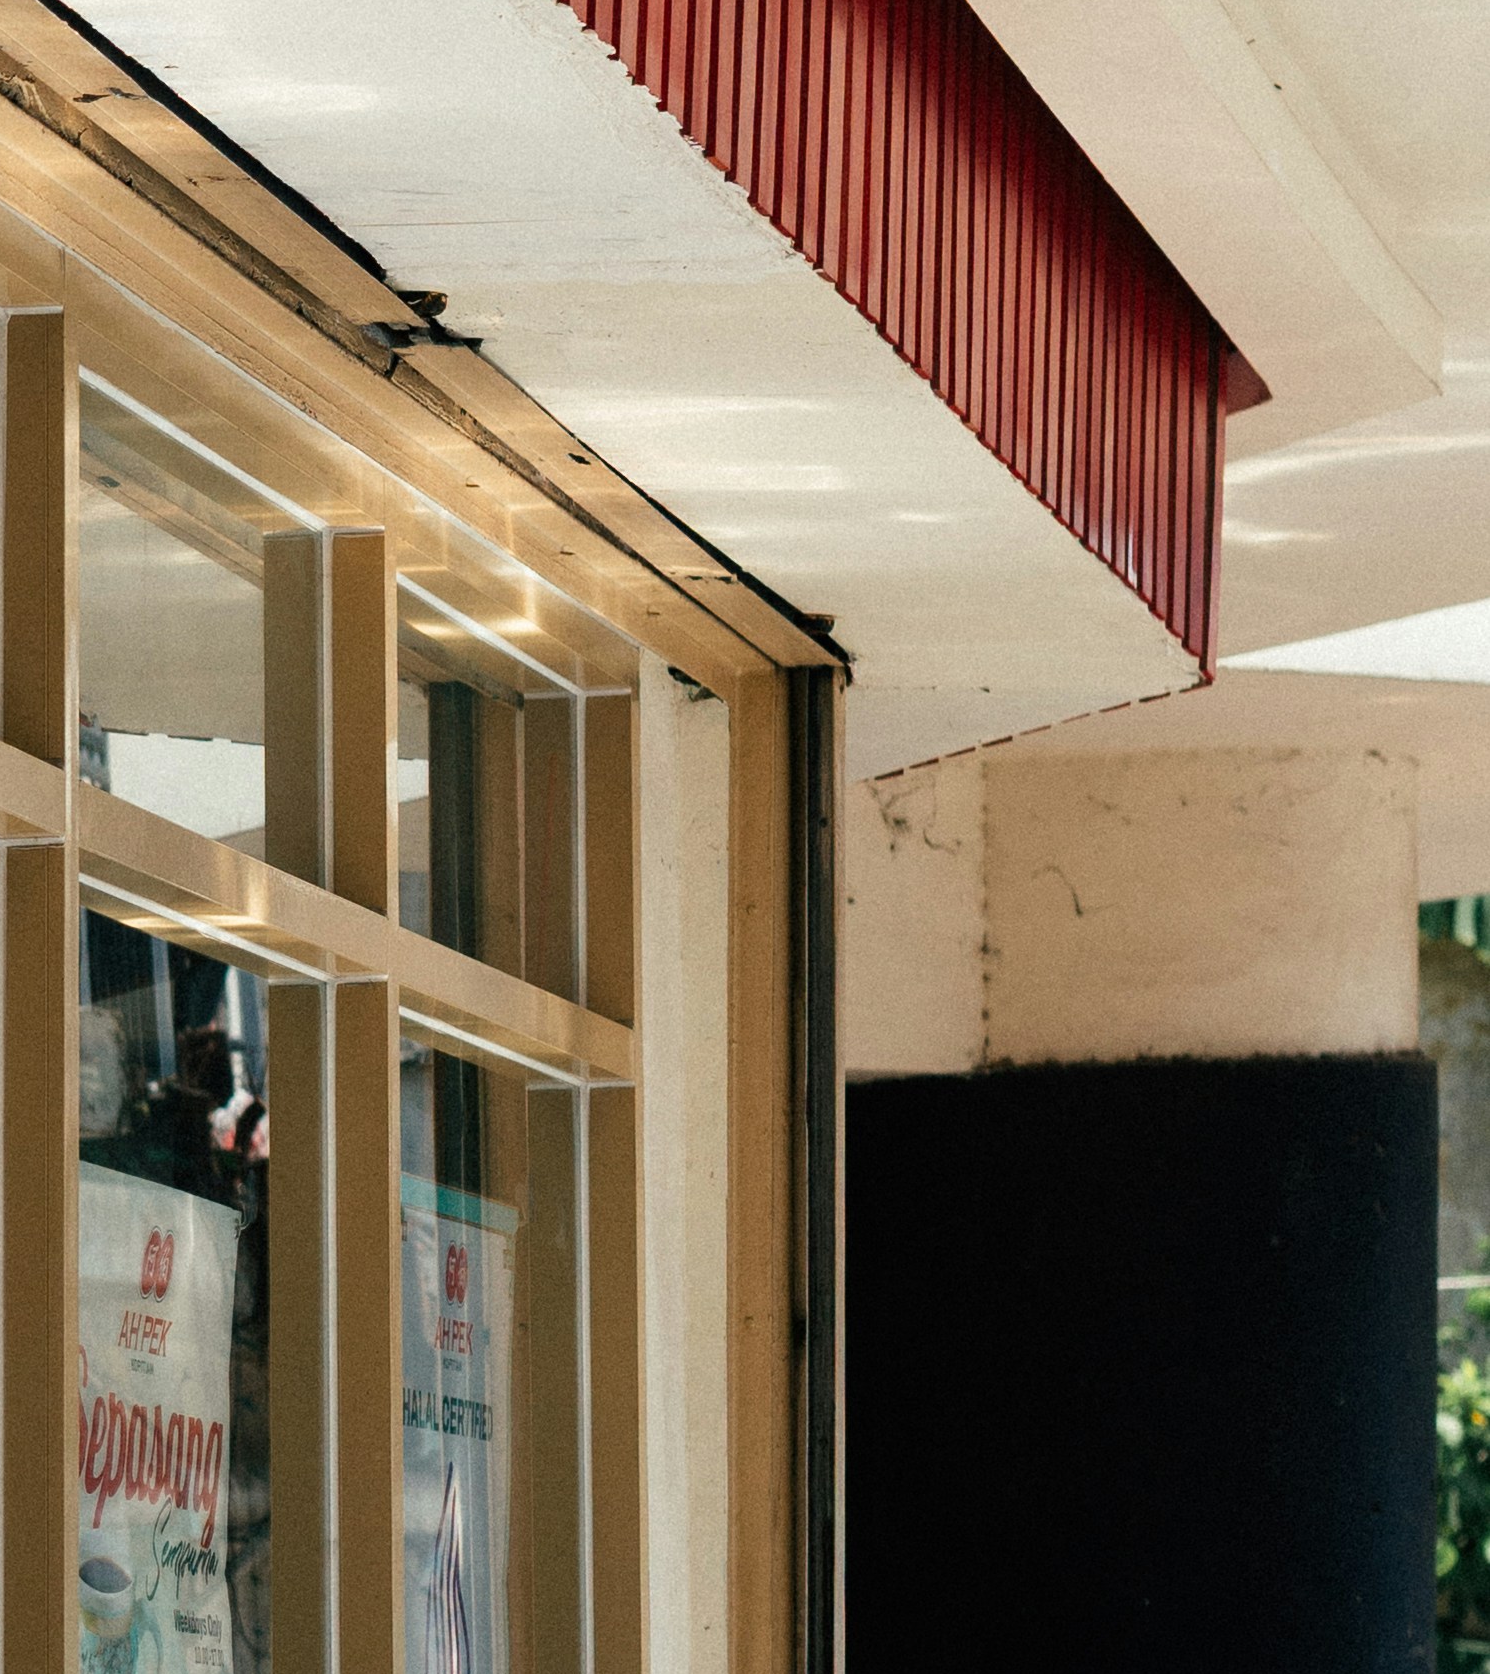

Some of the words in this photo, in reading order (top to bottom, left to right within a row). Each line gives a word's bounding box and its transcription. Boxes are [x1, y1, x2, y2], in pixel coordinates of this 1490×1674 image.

[118, 1310, 142, 1350] AH
[141, 1315, 173, 1357] PEK
[434, 1316, 451, 1350] AH
[451, 1320, 474, 1356] PEK
[402, 1386, 440, 1432] HALAL
[441, 1395, 494, 1442] CERTIFIED
